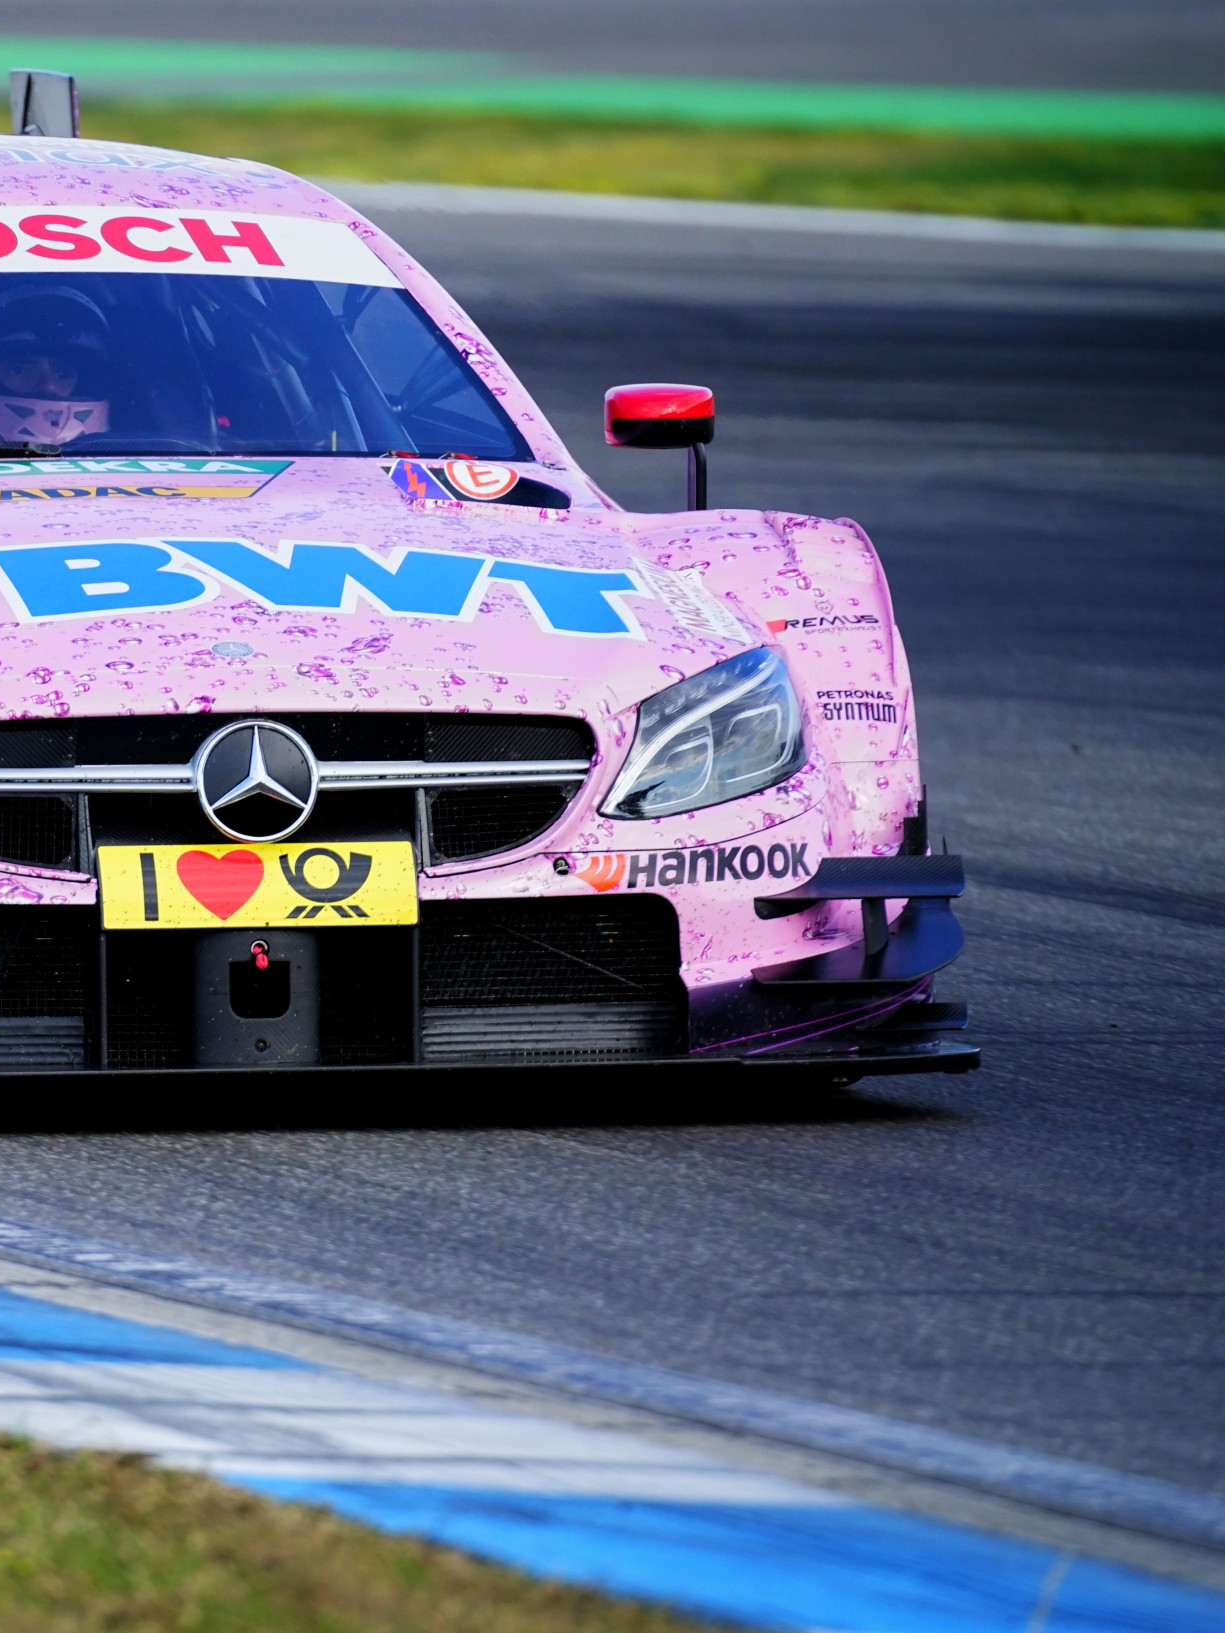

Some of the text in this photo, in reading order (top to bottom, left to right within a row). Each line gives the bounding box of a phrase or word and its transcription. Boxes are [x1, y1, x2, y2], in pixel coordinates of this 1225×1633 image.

[465, 463, 501, 489] E
[784, 614, 880, 631] REMUS
[816, 689, 894, 701] PETRONAS
[823, 702, 897, 724] SYNTIUM
[139, 852, 160, 922] I
